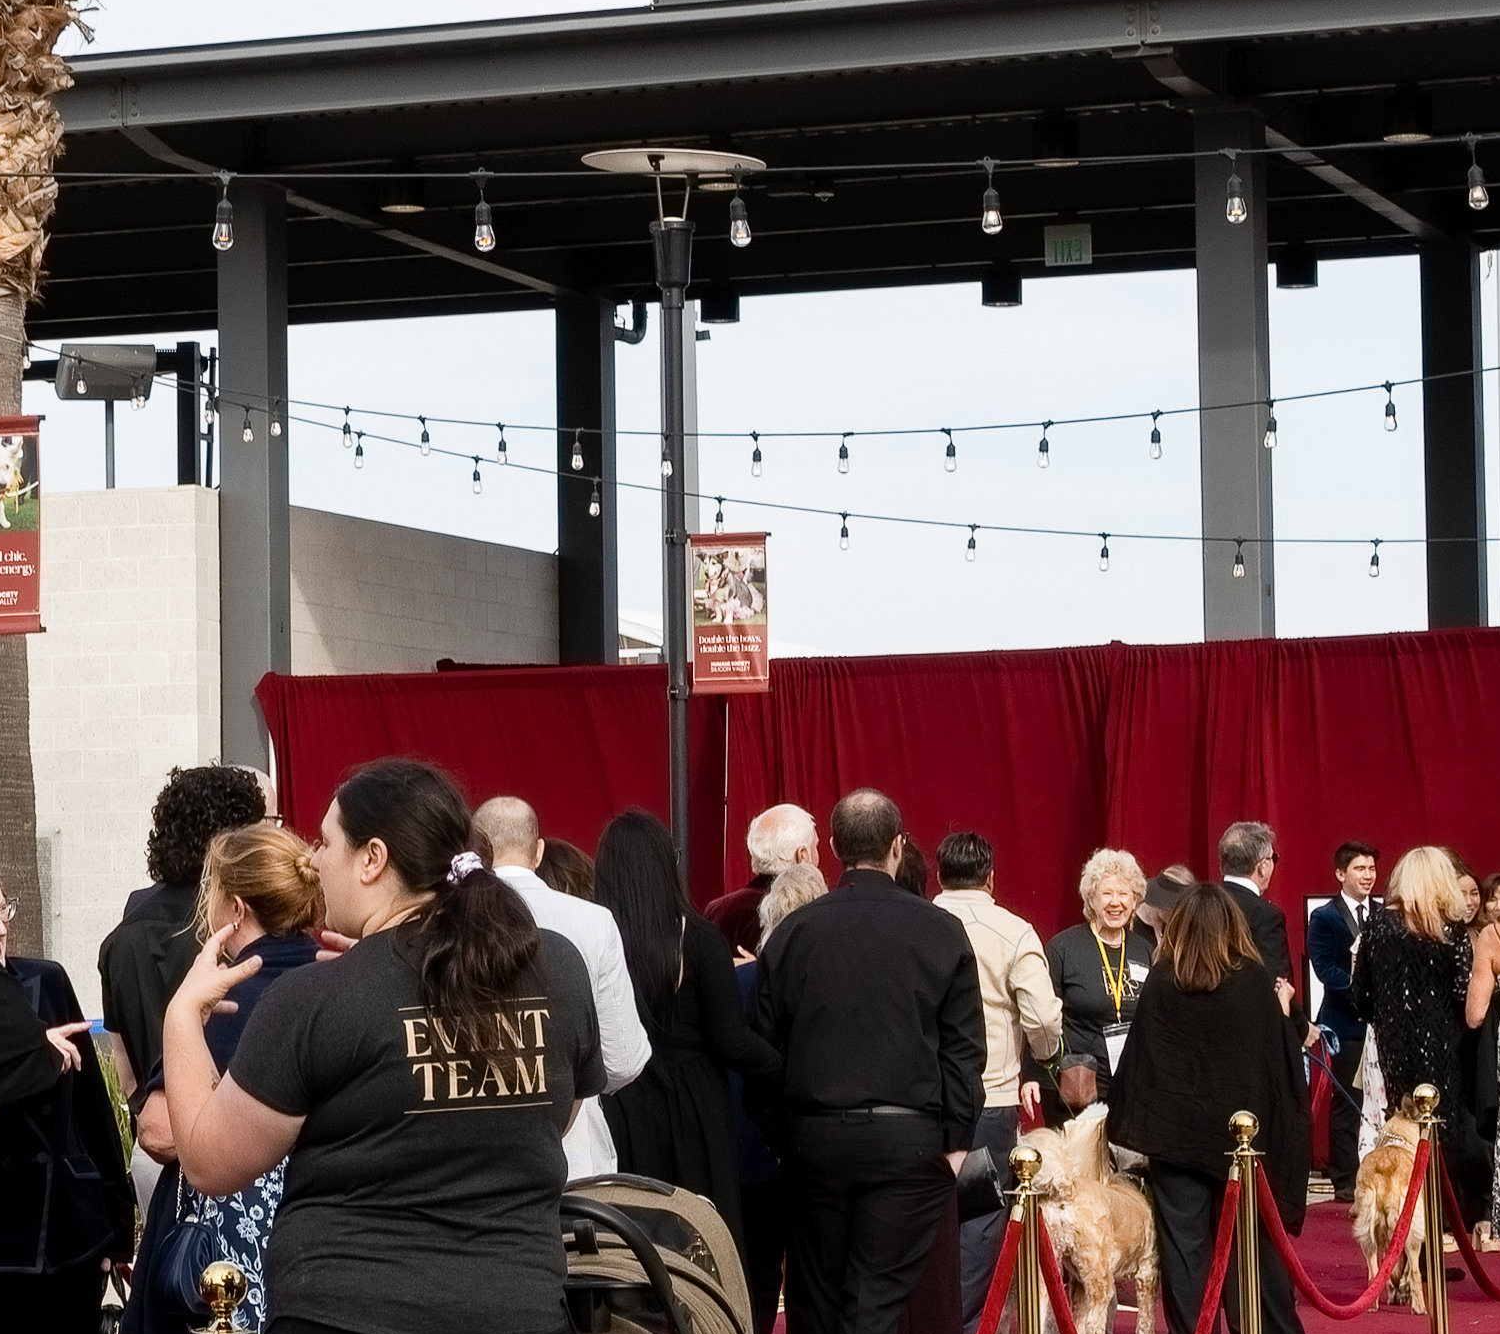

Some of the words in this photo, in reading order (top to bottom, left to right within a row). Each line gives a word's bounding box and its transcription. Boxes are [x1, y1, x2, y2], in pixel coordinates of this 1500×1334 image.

[4, 550, 27, 562] chic,
[699, 634, 725, 644] Double
[725, 634, 739, 644] the
[700, 644, 726, 653] double
[726, 644, 740, 653] the
[403, 1009, 550, 1057] EVNT
[412, 1054, 547, 1101] TEAM
